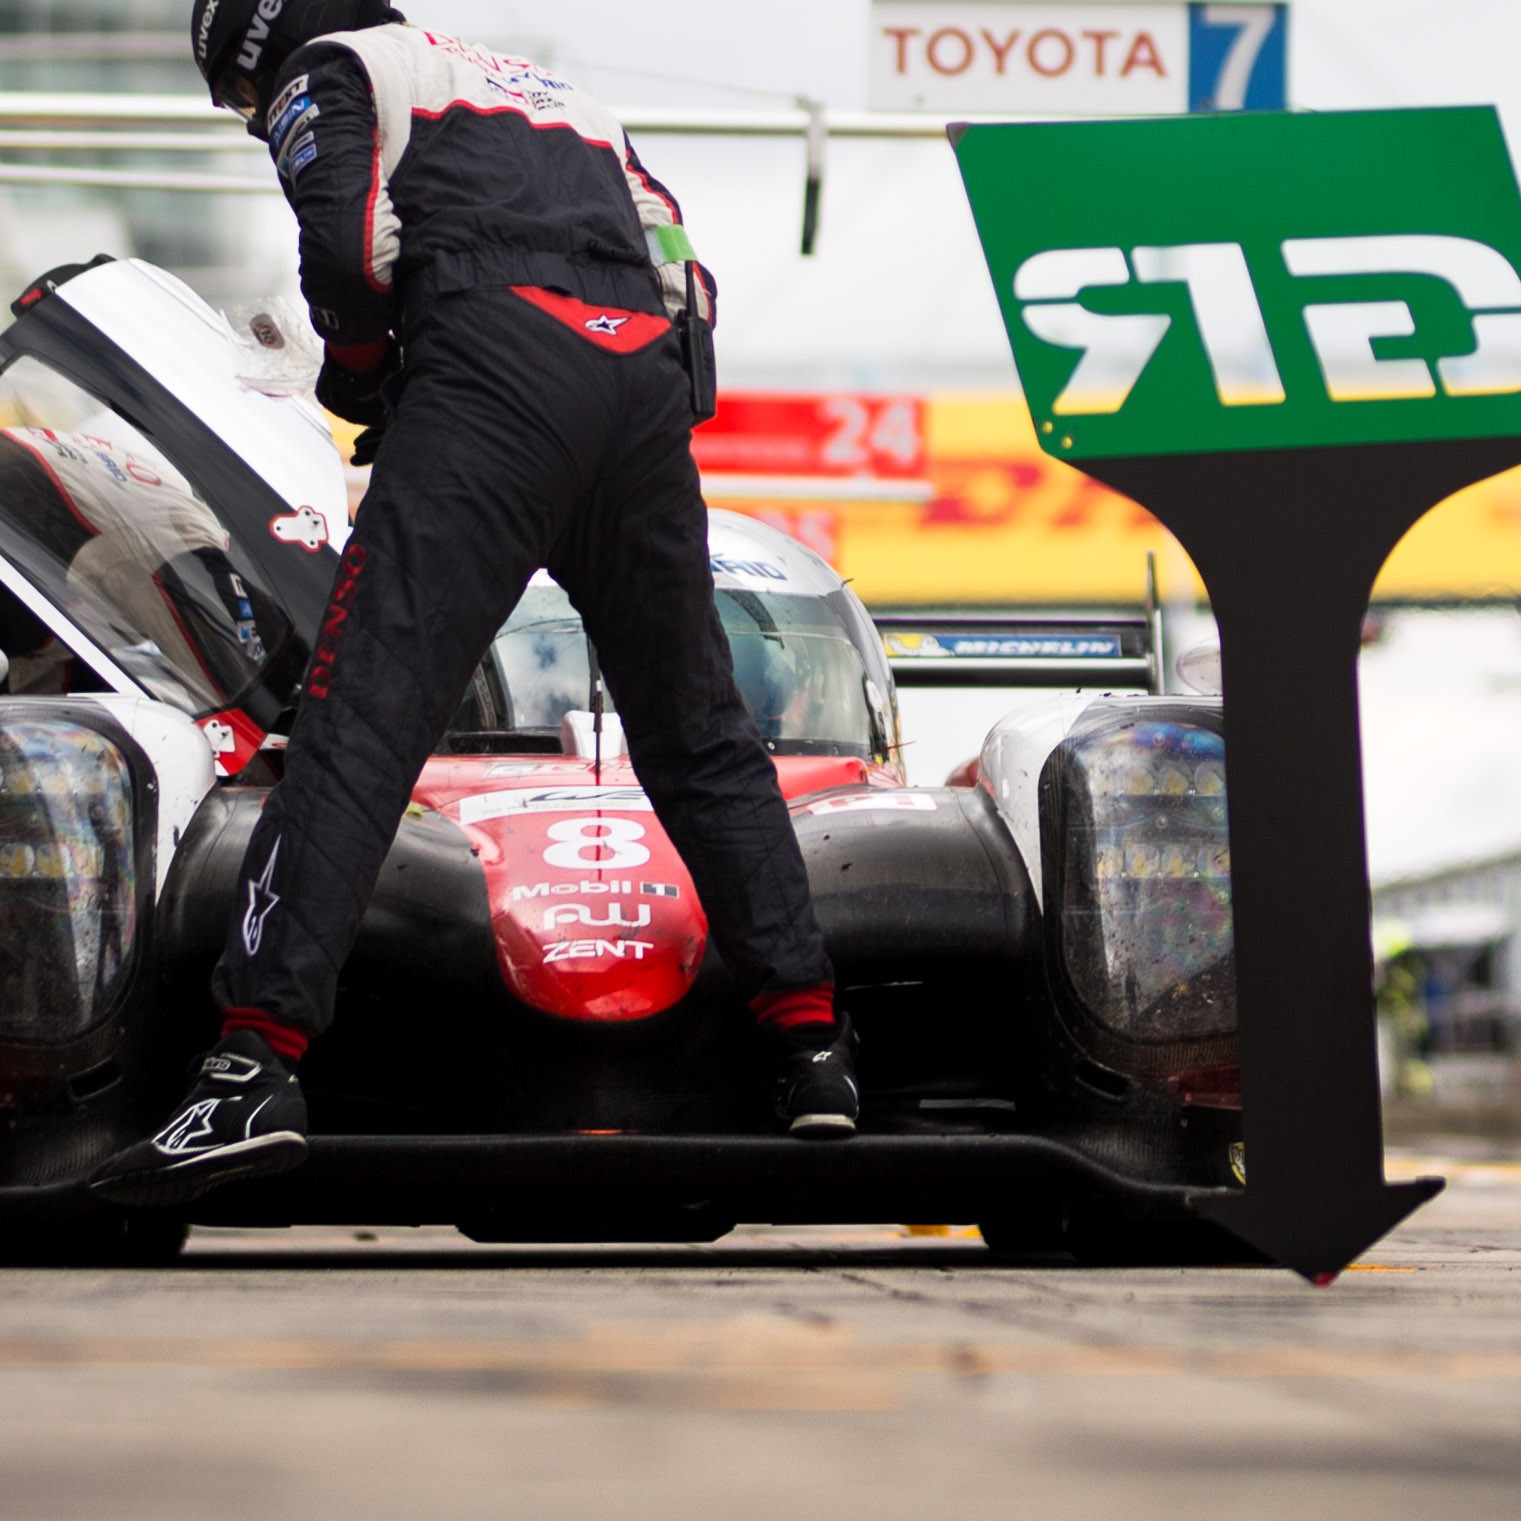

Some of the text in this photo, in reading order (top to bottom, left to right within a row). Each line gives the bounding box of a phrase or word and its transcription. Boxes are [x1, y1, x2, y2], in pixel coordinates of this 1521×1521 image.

[883, 5, 1277, 110] TOYOTA 7
[822, 397, 920, 466] 24
[308, 543, 367, 699] DENSO
[954, 639, 1116, 657] MICHELIN
[543, 816, 651, 870] 8
[511, 879, 632, 902] Mobil
[542, 939, 655, 964] ZENT
